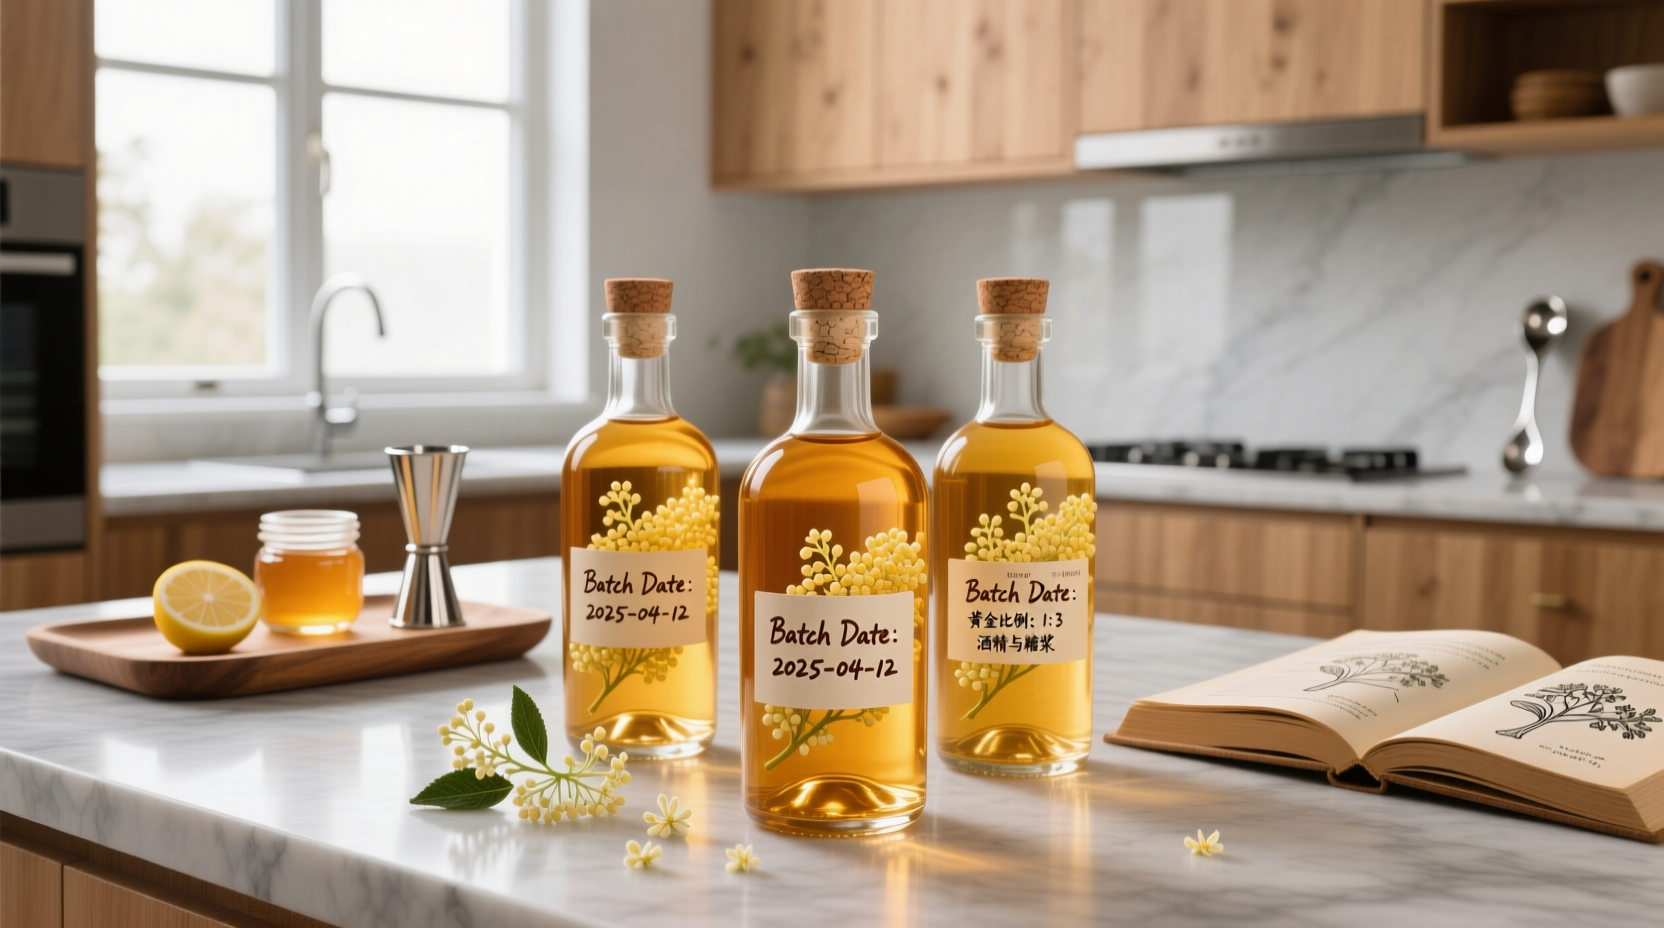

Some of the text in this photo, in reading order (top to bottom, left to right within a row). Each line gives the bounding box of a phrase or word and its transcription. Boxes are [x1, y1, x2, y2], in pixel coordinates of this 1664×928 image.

[583, 568, 693, 596] Batch Date:
[965, 578, 1077, 604] Batch Date:
[585, 603, 690, 625] 2025-04-12
[769, 615, 898, 648] Batch Date:
[771, 657, 899, 681] 2025-04-12
